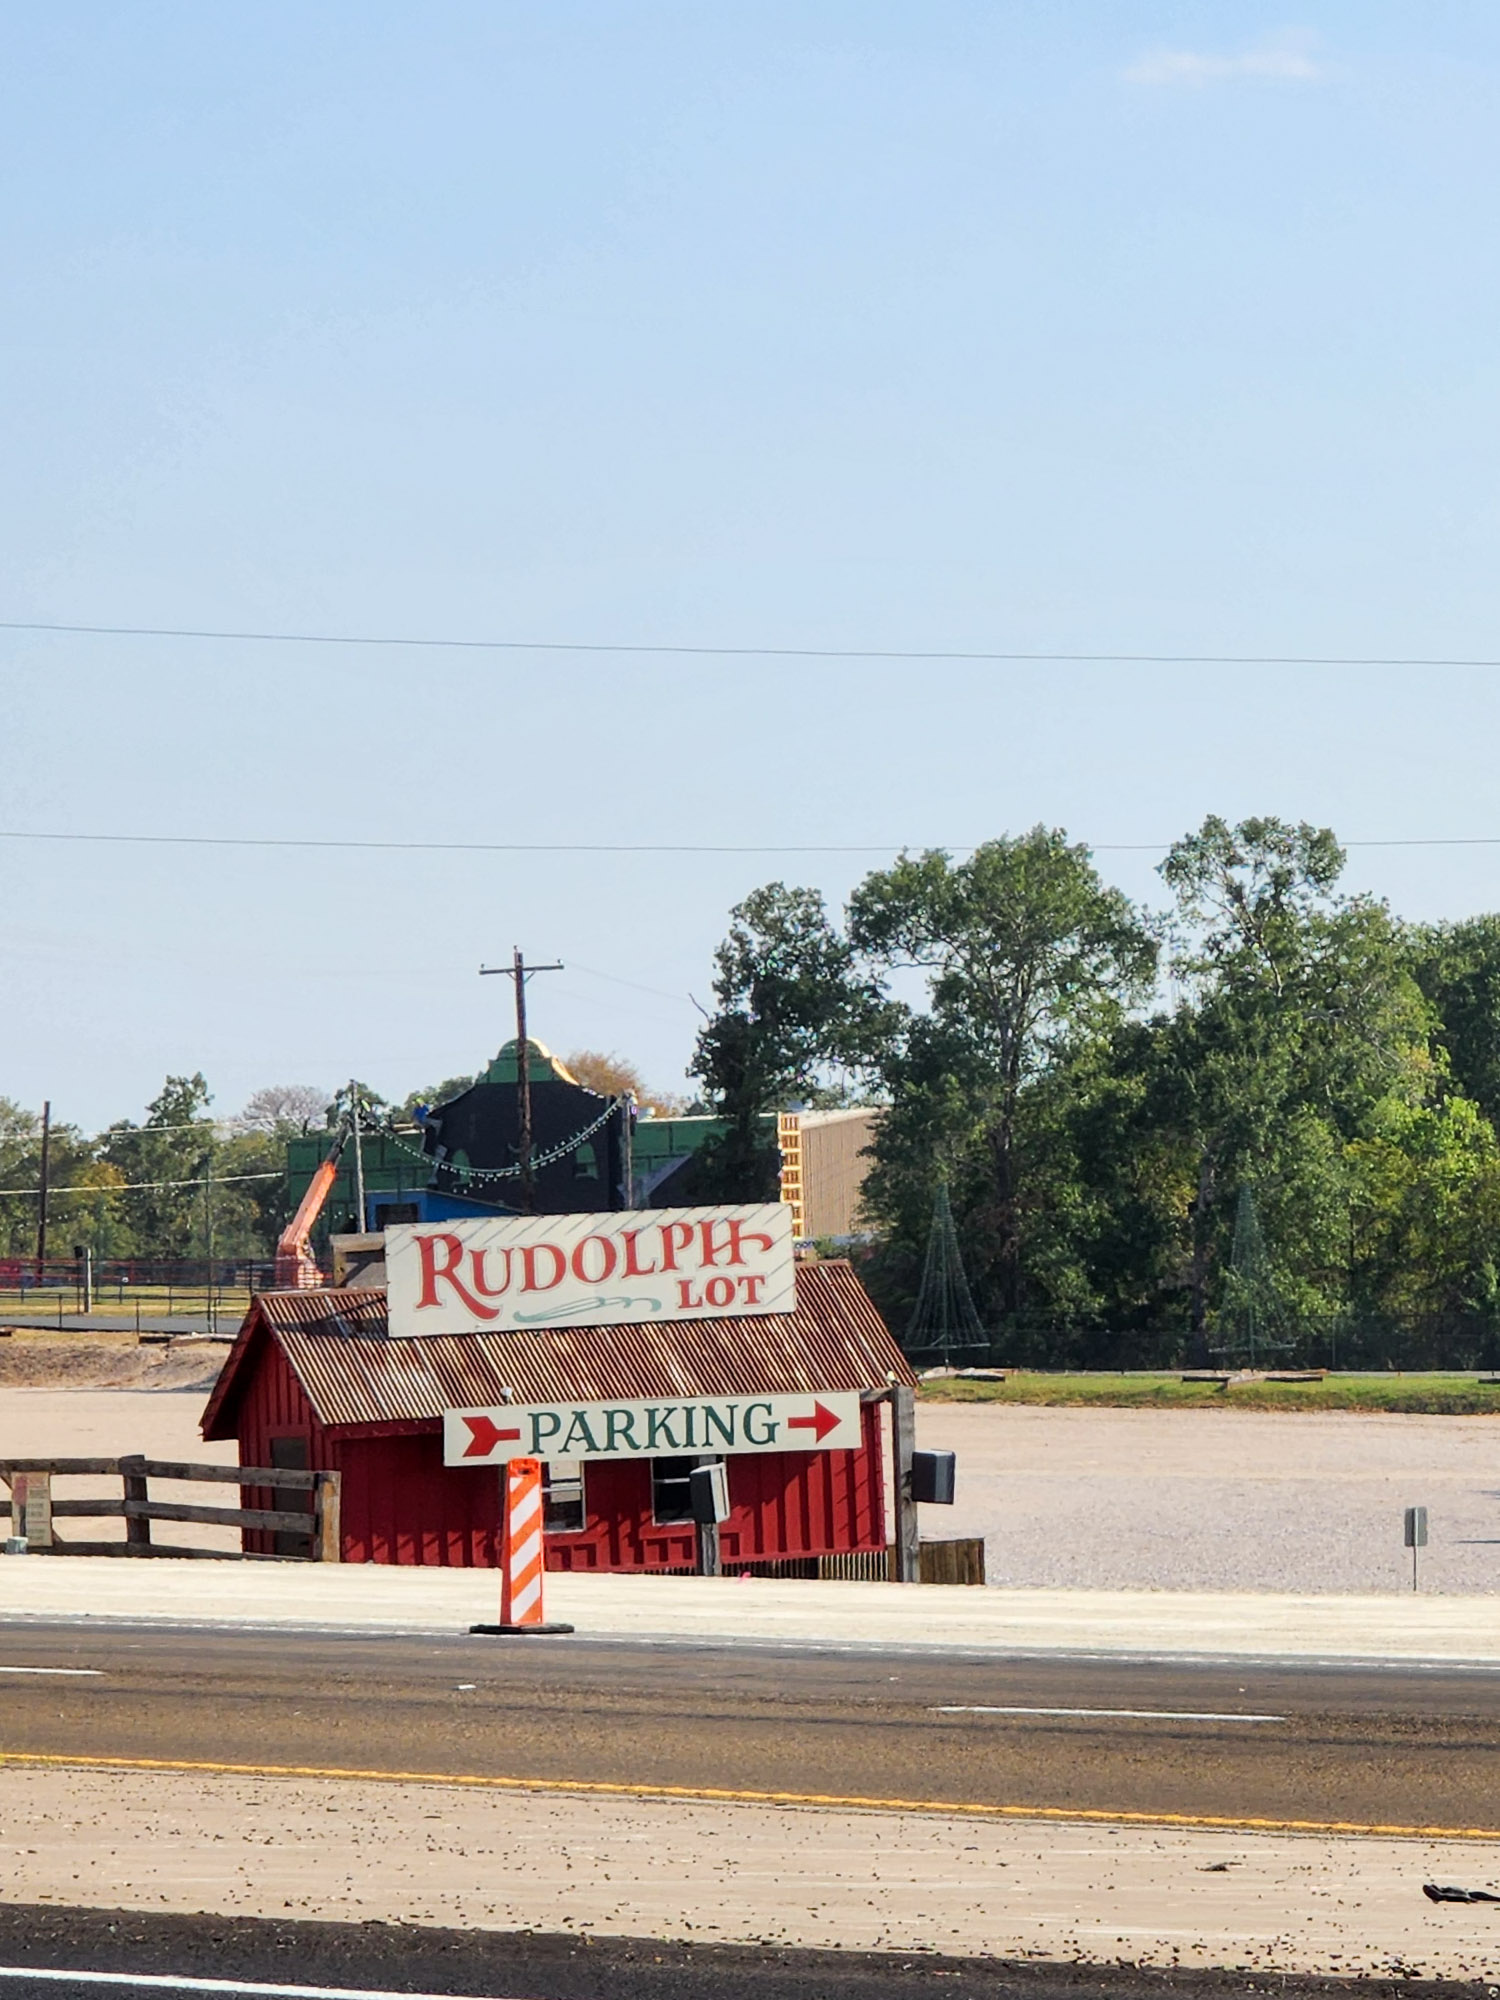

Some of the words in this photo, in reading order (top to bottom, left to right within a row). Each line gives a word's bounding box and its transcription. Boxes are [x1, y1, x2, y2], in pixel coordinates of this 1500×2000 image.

[412, 1218, 774, 1321] RUDOLPH
[676, 1275, 767, 1311] LOT
[527, 1402, 781, 1455] PARKING
